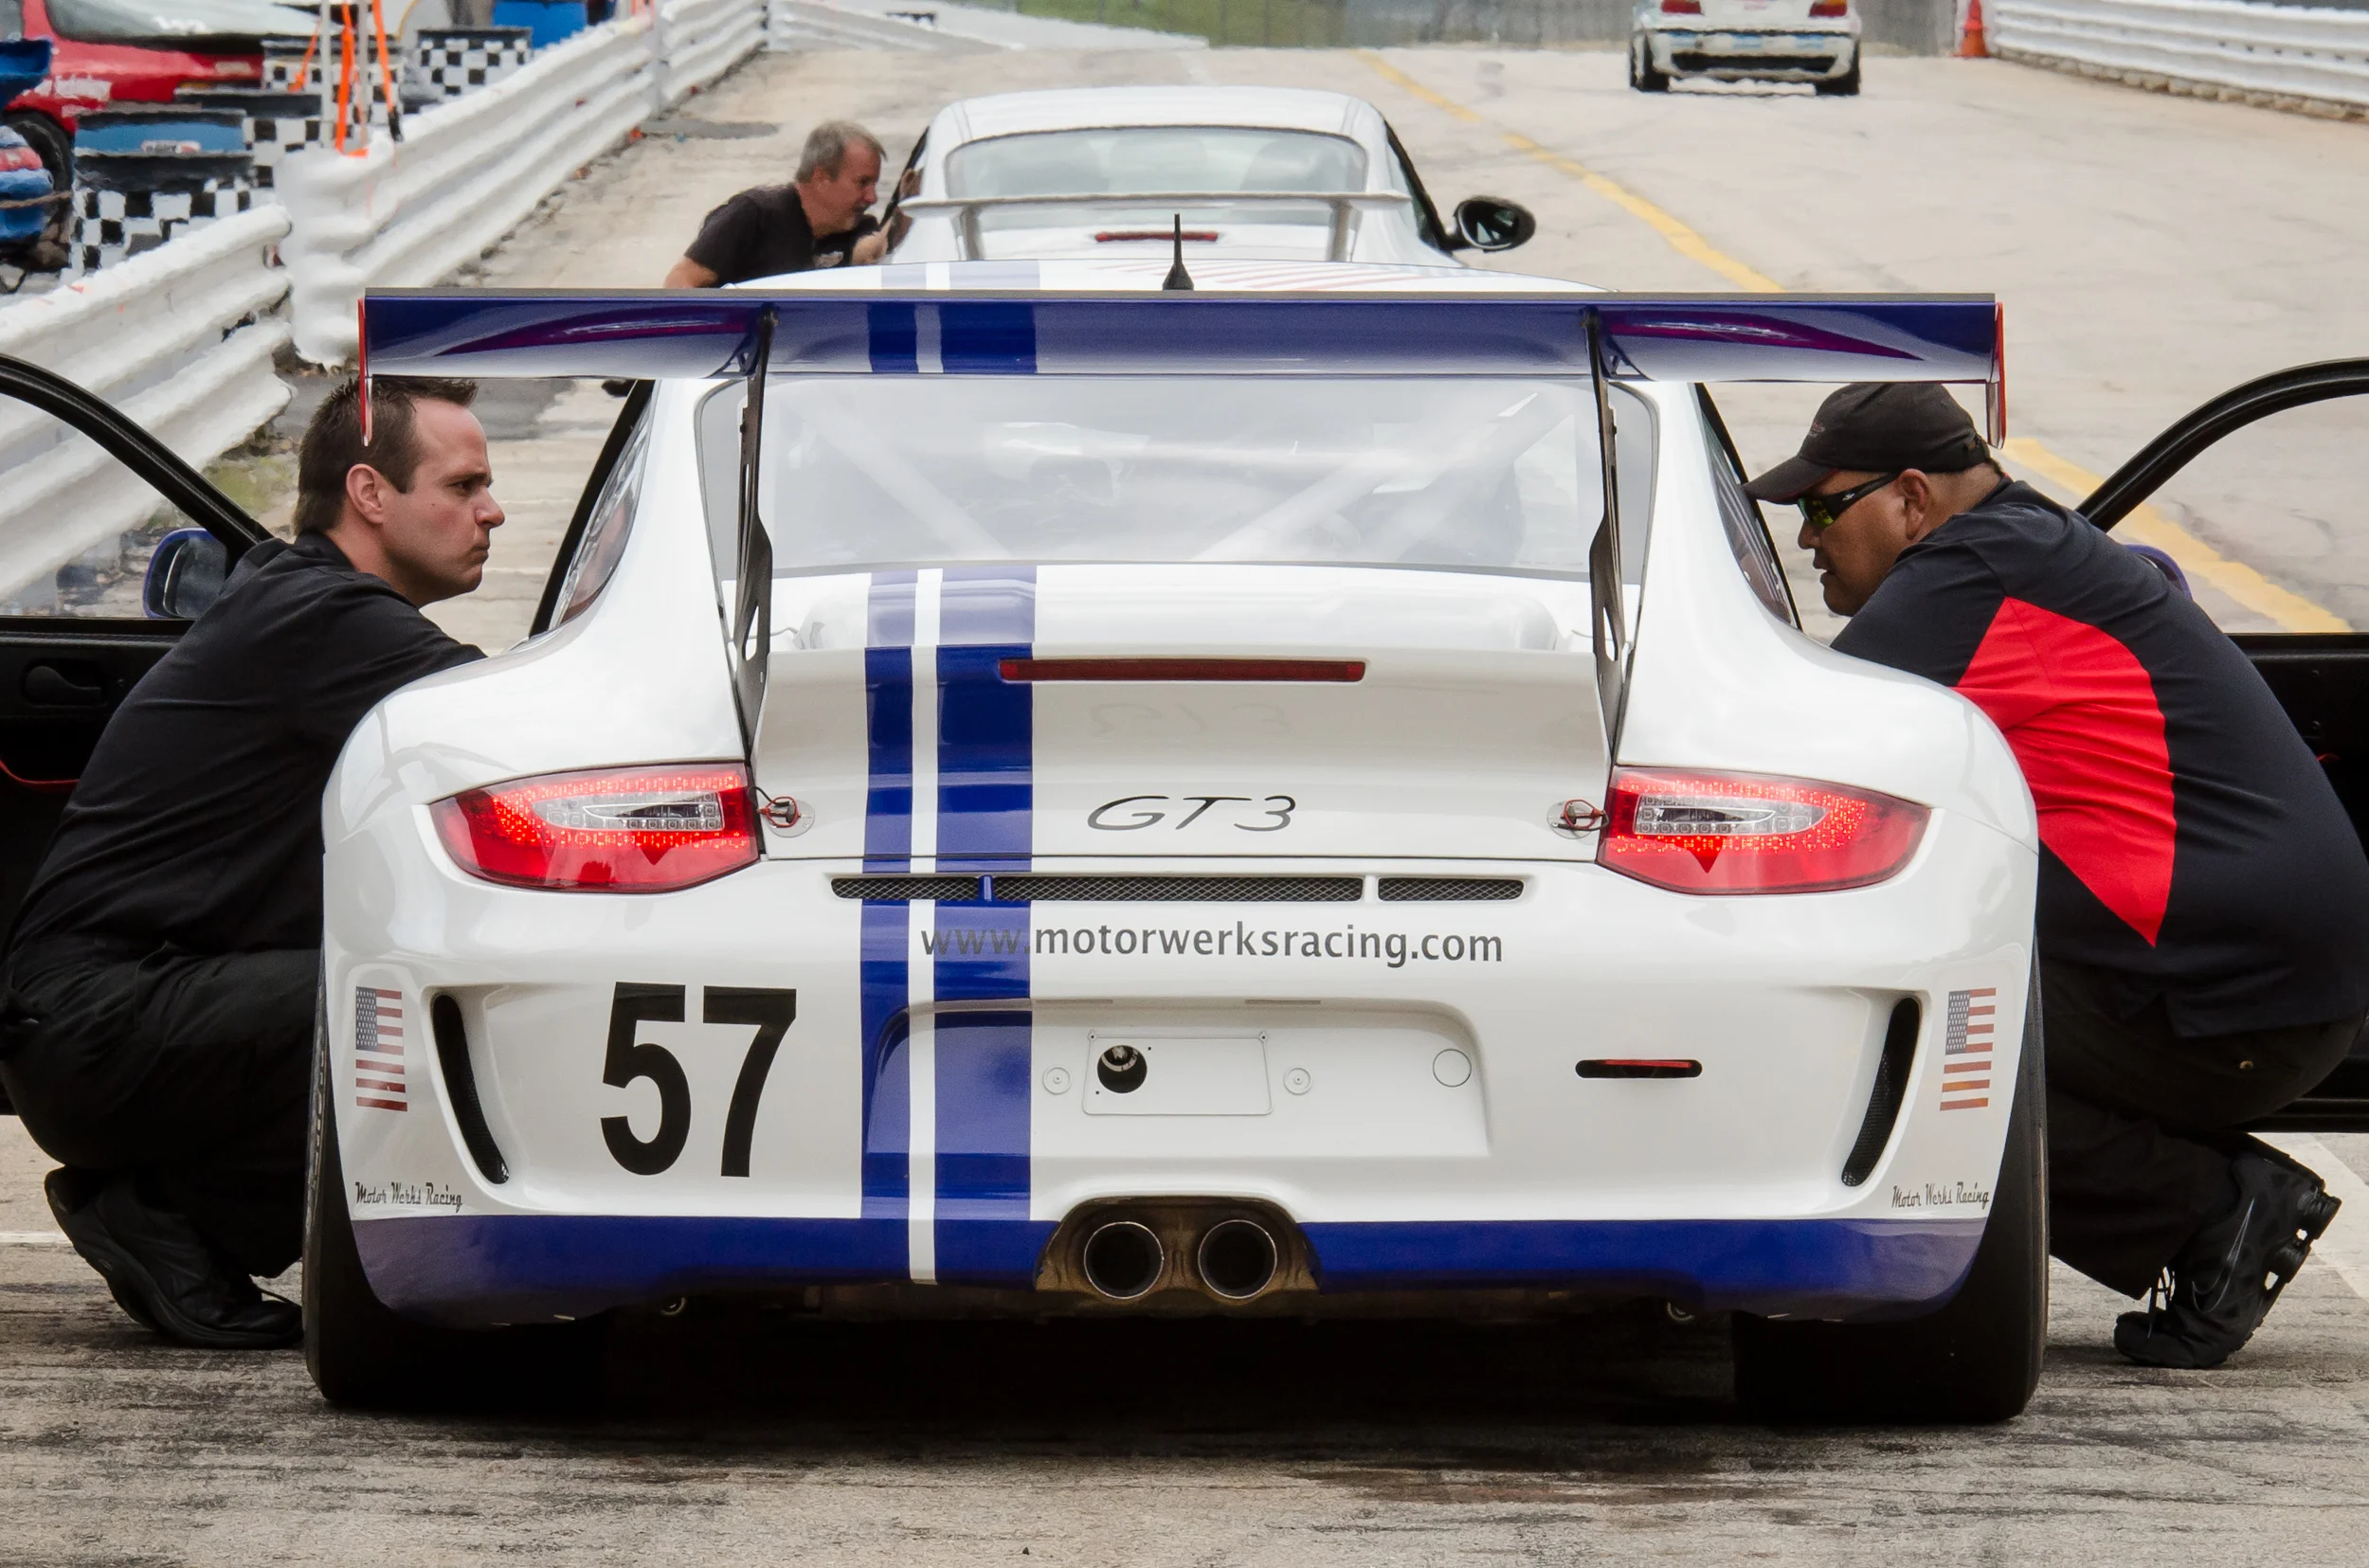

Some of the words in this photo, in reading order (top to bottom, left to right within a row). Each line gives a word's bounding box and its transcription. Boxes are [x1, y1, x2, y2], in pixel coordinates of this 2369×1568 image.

[1087, 795, 1296, 832] GT3
[921, 921, 1504, 969] www.motorwerksracing.com
[600, 982, 797, 1178] 57
[354, 1181, 388, 1205] Motor
[390, 1181, 423, 1206] Werks
[425, 1181, 463, 1214] Racing
[1891, 1185, 1922, 1208] Motor
[1925, 1182, 1953, 1206] Werks
[1956, 1181, 1990, 1210] Racing
